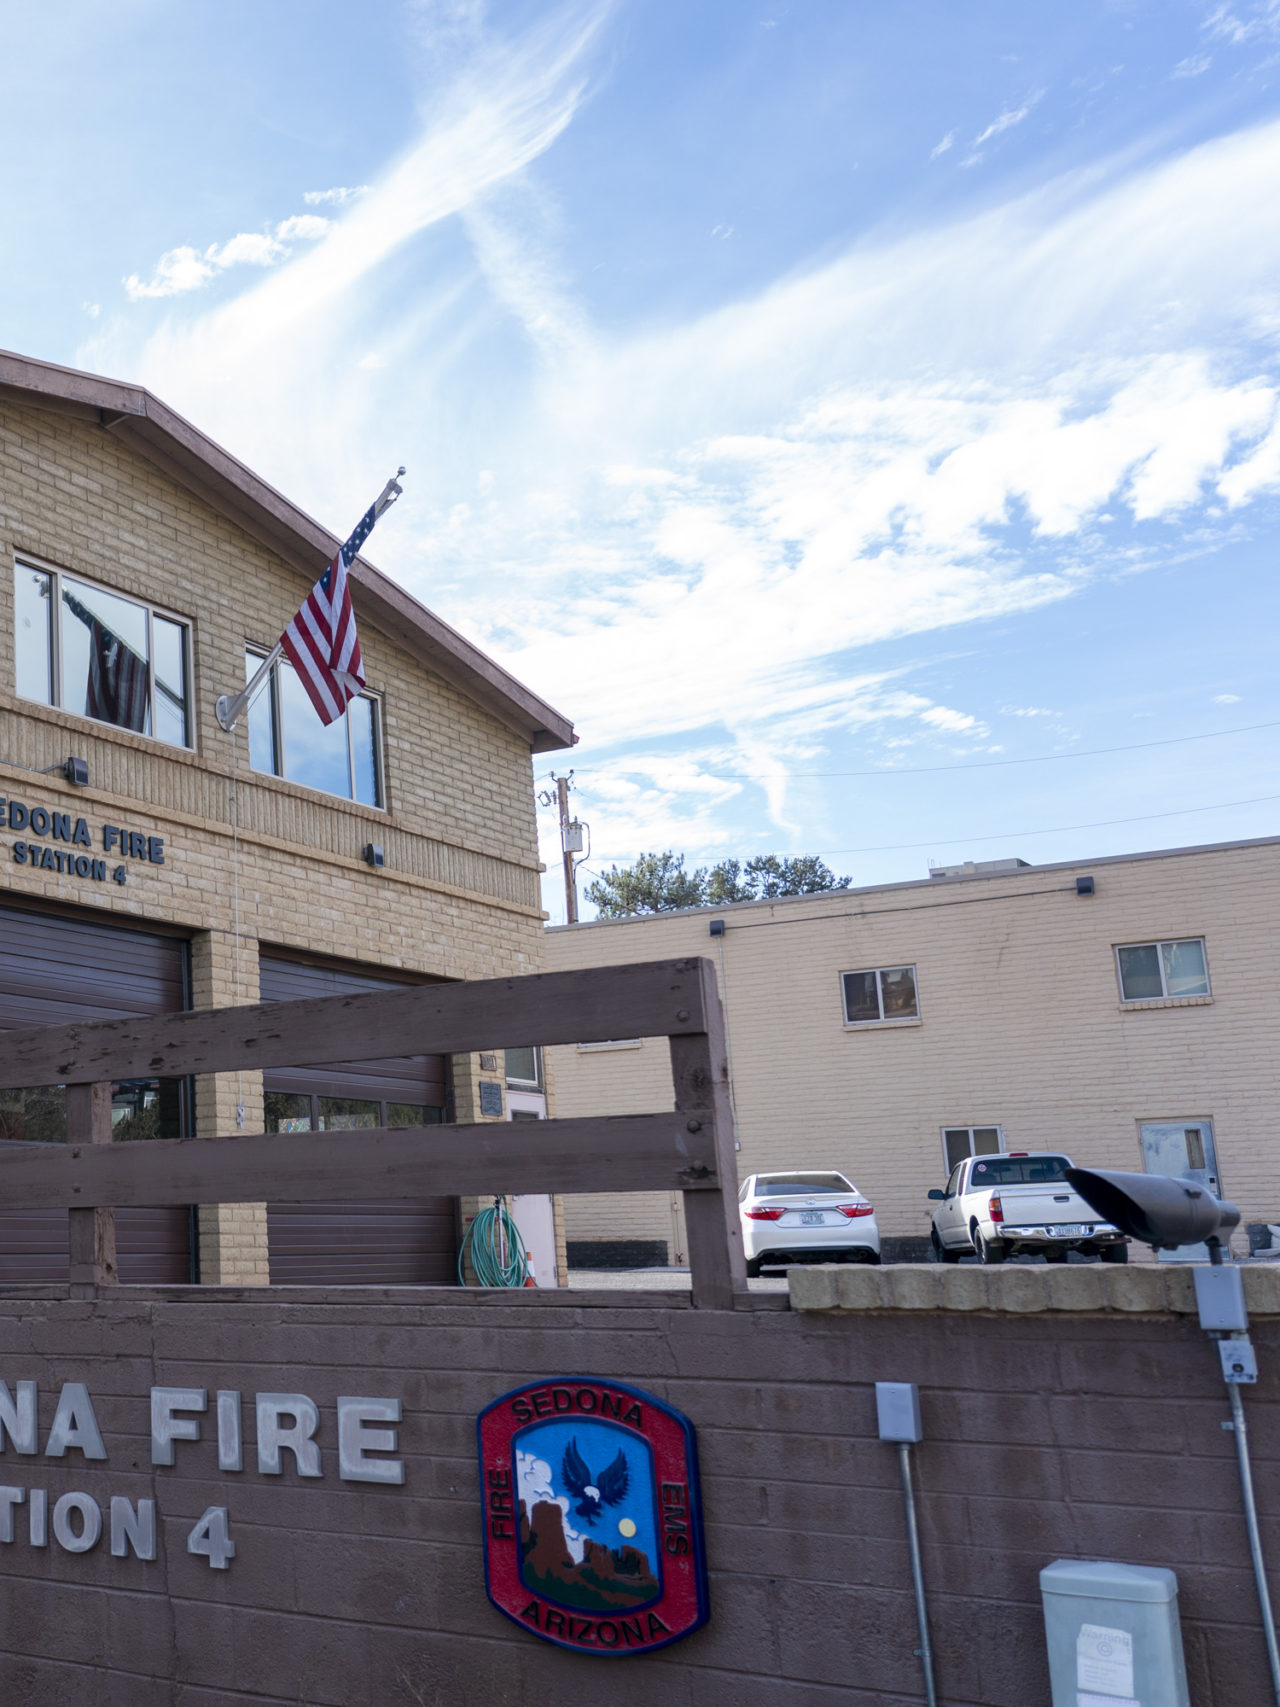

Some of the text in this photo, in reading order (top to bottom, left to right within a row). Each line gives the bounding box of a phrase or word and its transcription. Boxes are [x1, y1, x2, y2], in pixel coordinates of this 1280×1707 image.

[14, 841, 126, 885] STATION 4
[104, 825, 165, 864] FIRE
[151, 1386, 405, 1485] FIRE
[511, 1388, 642, 1429] SEDONA
[488, 1468, 512, 1540] FIRE
[662, 1482, 688, 1556] EMS
[187, 1506, 235, 1569] 4
[520, 1601, 671, 1646] ARIZONA
